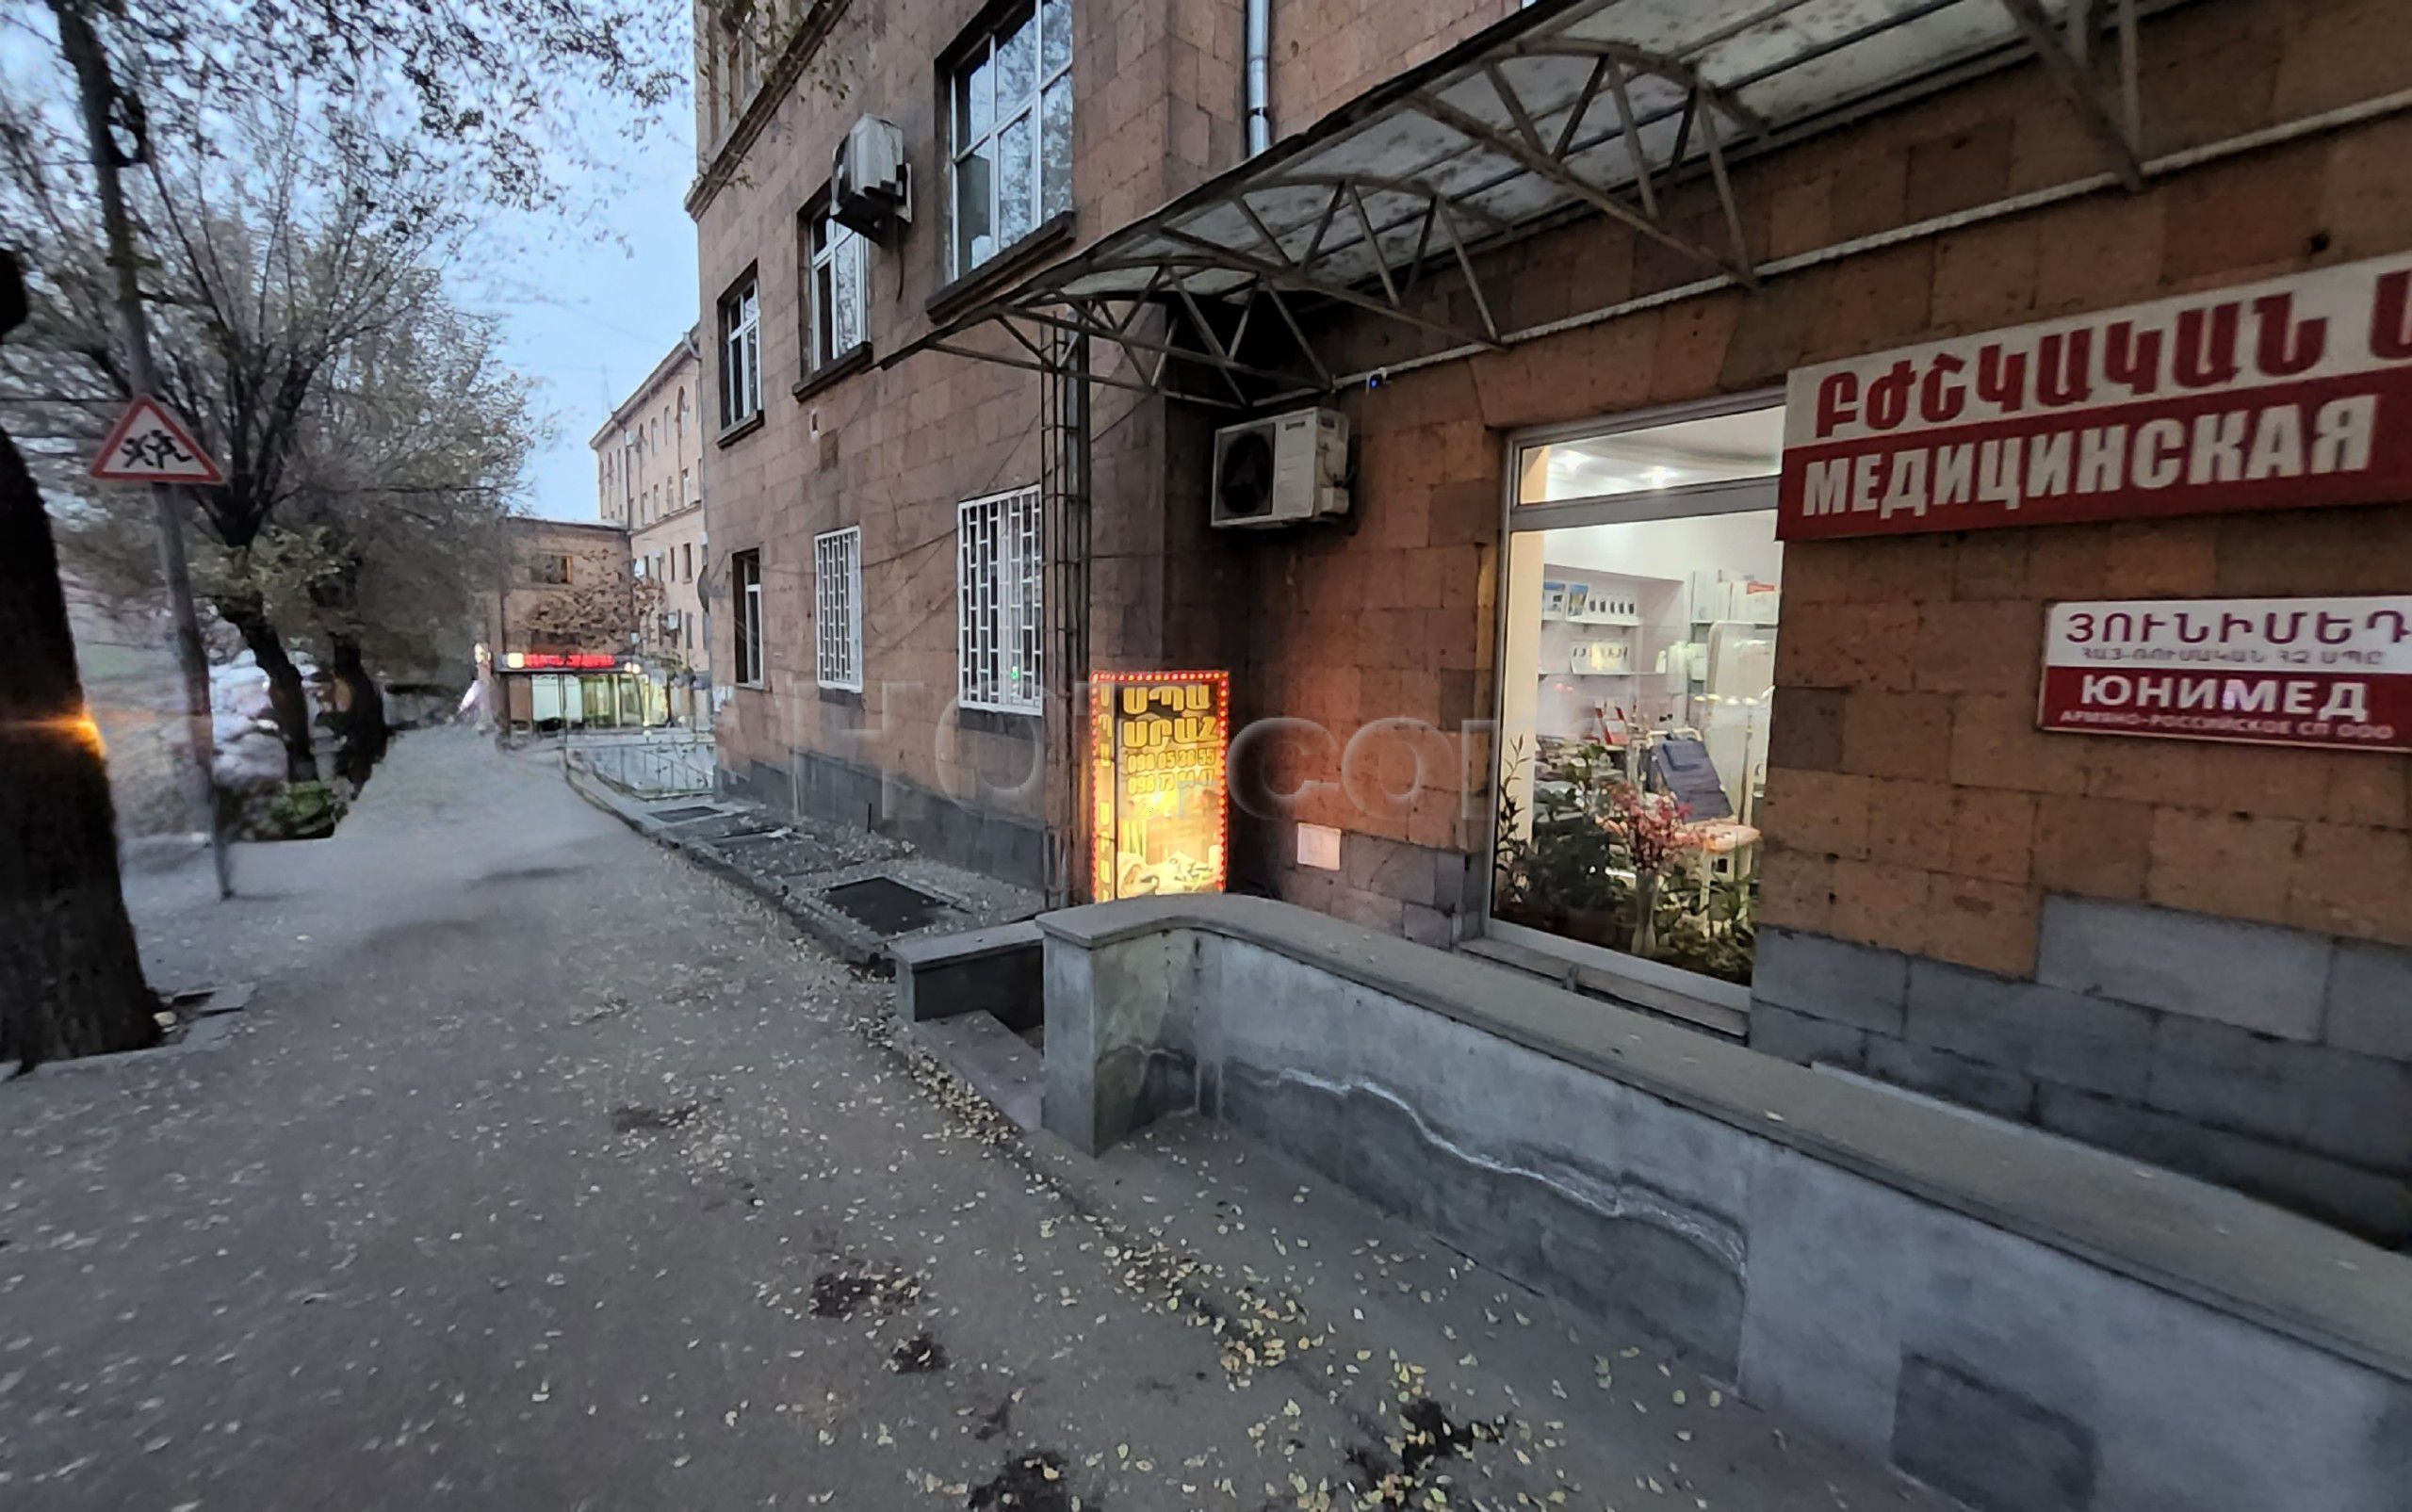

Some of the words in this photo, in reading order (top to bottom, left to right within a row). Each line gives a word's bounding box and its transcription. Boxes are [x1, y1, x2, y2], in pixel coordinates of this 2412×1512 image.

[1816, 292, 2327, 438] ԲԺՇԿԱԿԱՆ
[1801, 394, 2379, 520] МЕДИЦИНСКАЯ
[2065, 610, 2411, 644] ՅՈՒՆԻՄԵԴ
[1123, 684, 1212, 715] ՍՊԱ
[2080, 674, 2370, 723] ЮНИМЕД
[1123, 715, 1220, 749] ՍՐԱՀ
[2337, 723, 2396, 740] ООО
